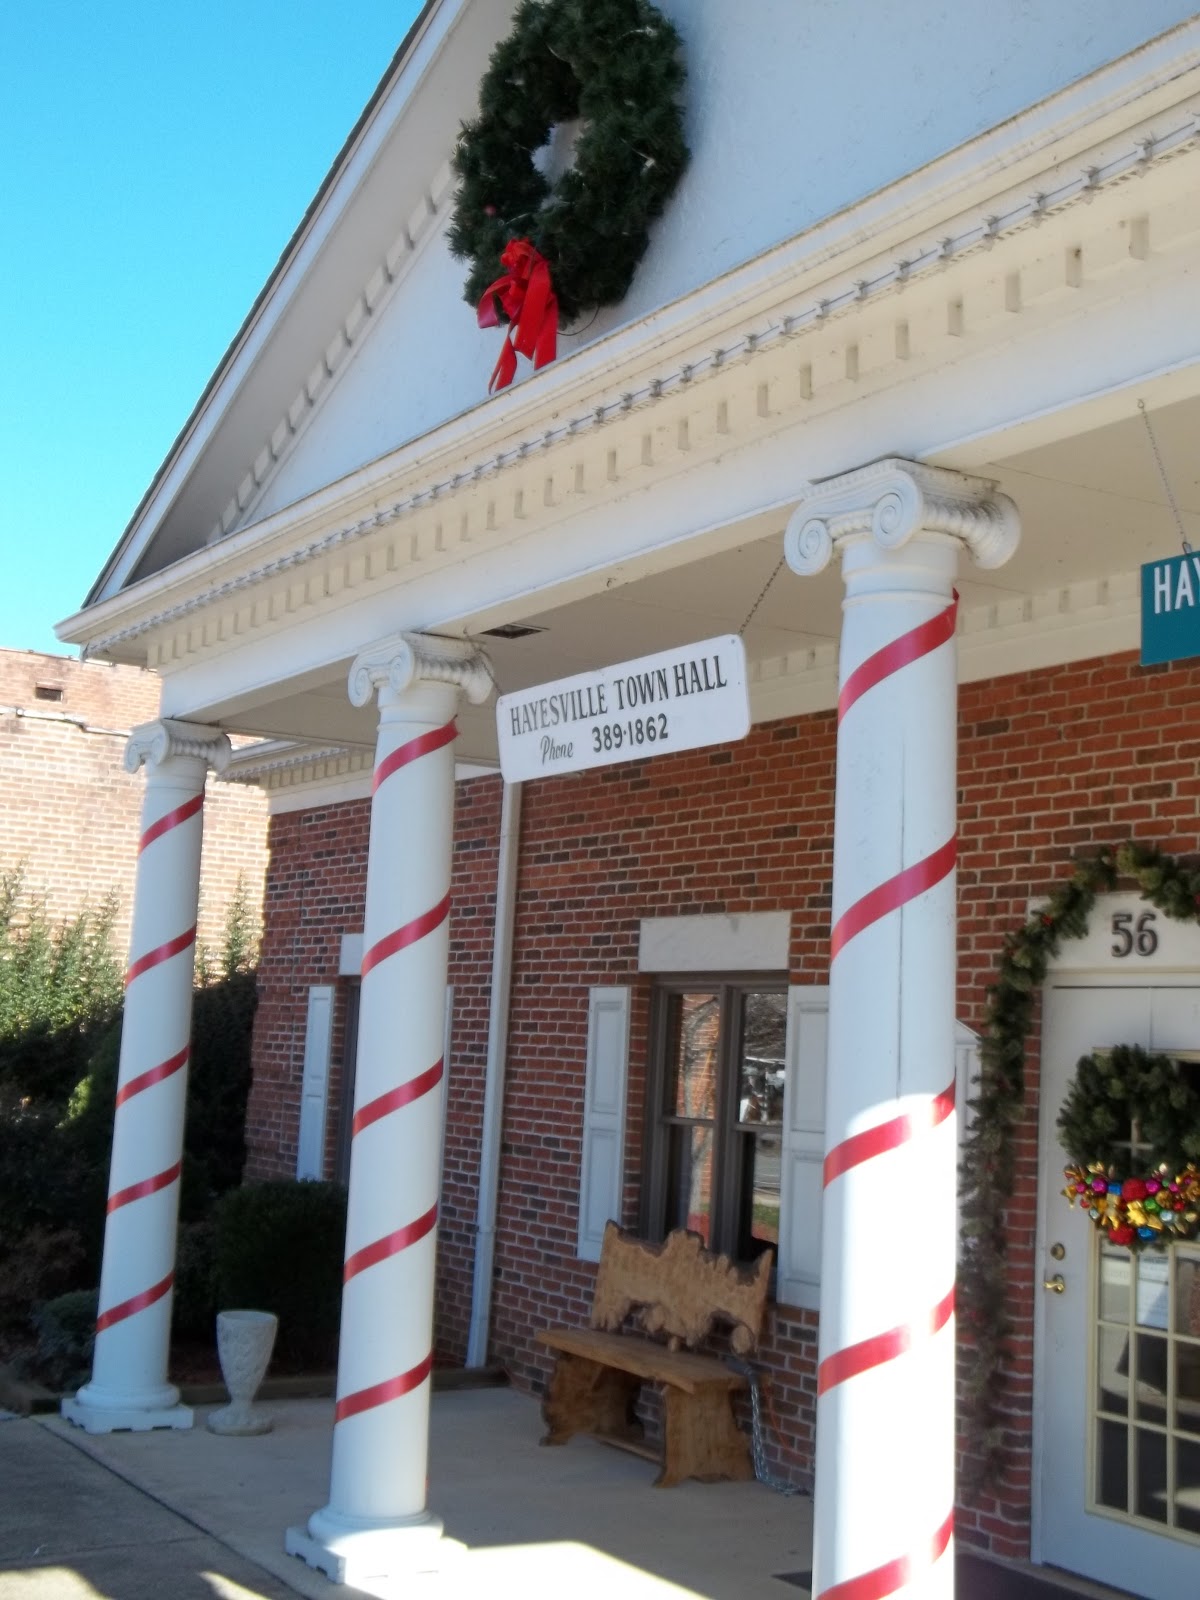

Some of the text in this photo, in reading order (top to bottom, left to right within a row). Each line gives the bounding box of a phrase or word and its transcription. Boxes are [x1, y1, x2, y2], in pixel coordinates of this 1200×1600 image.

[510, 655, 727, 736] HAYESVILLE TOWN HALL
[540, 735, 574, 765] Phone
[1111, 913, 1158, 957] 56
